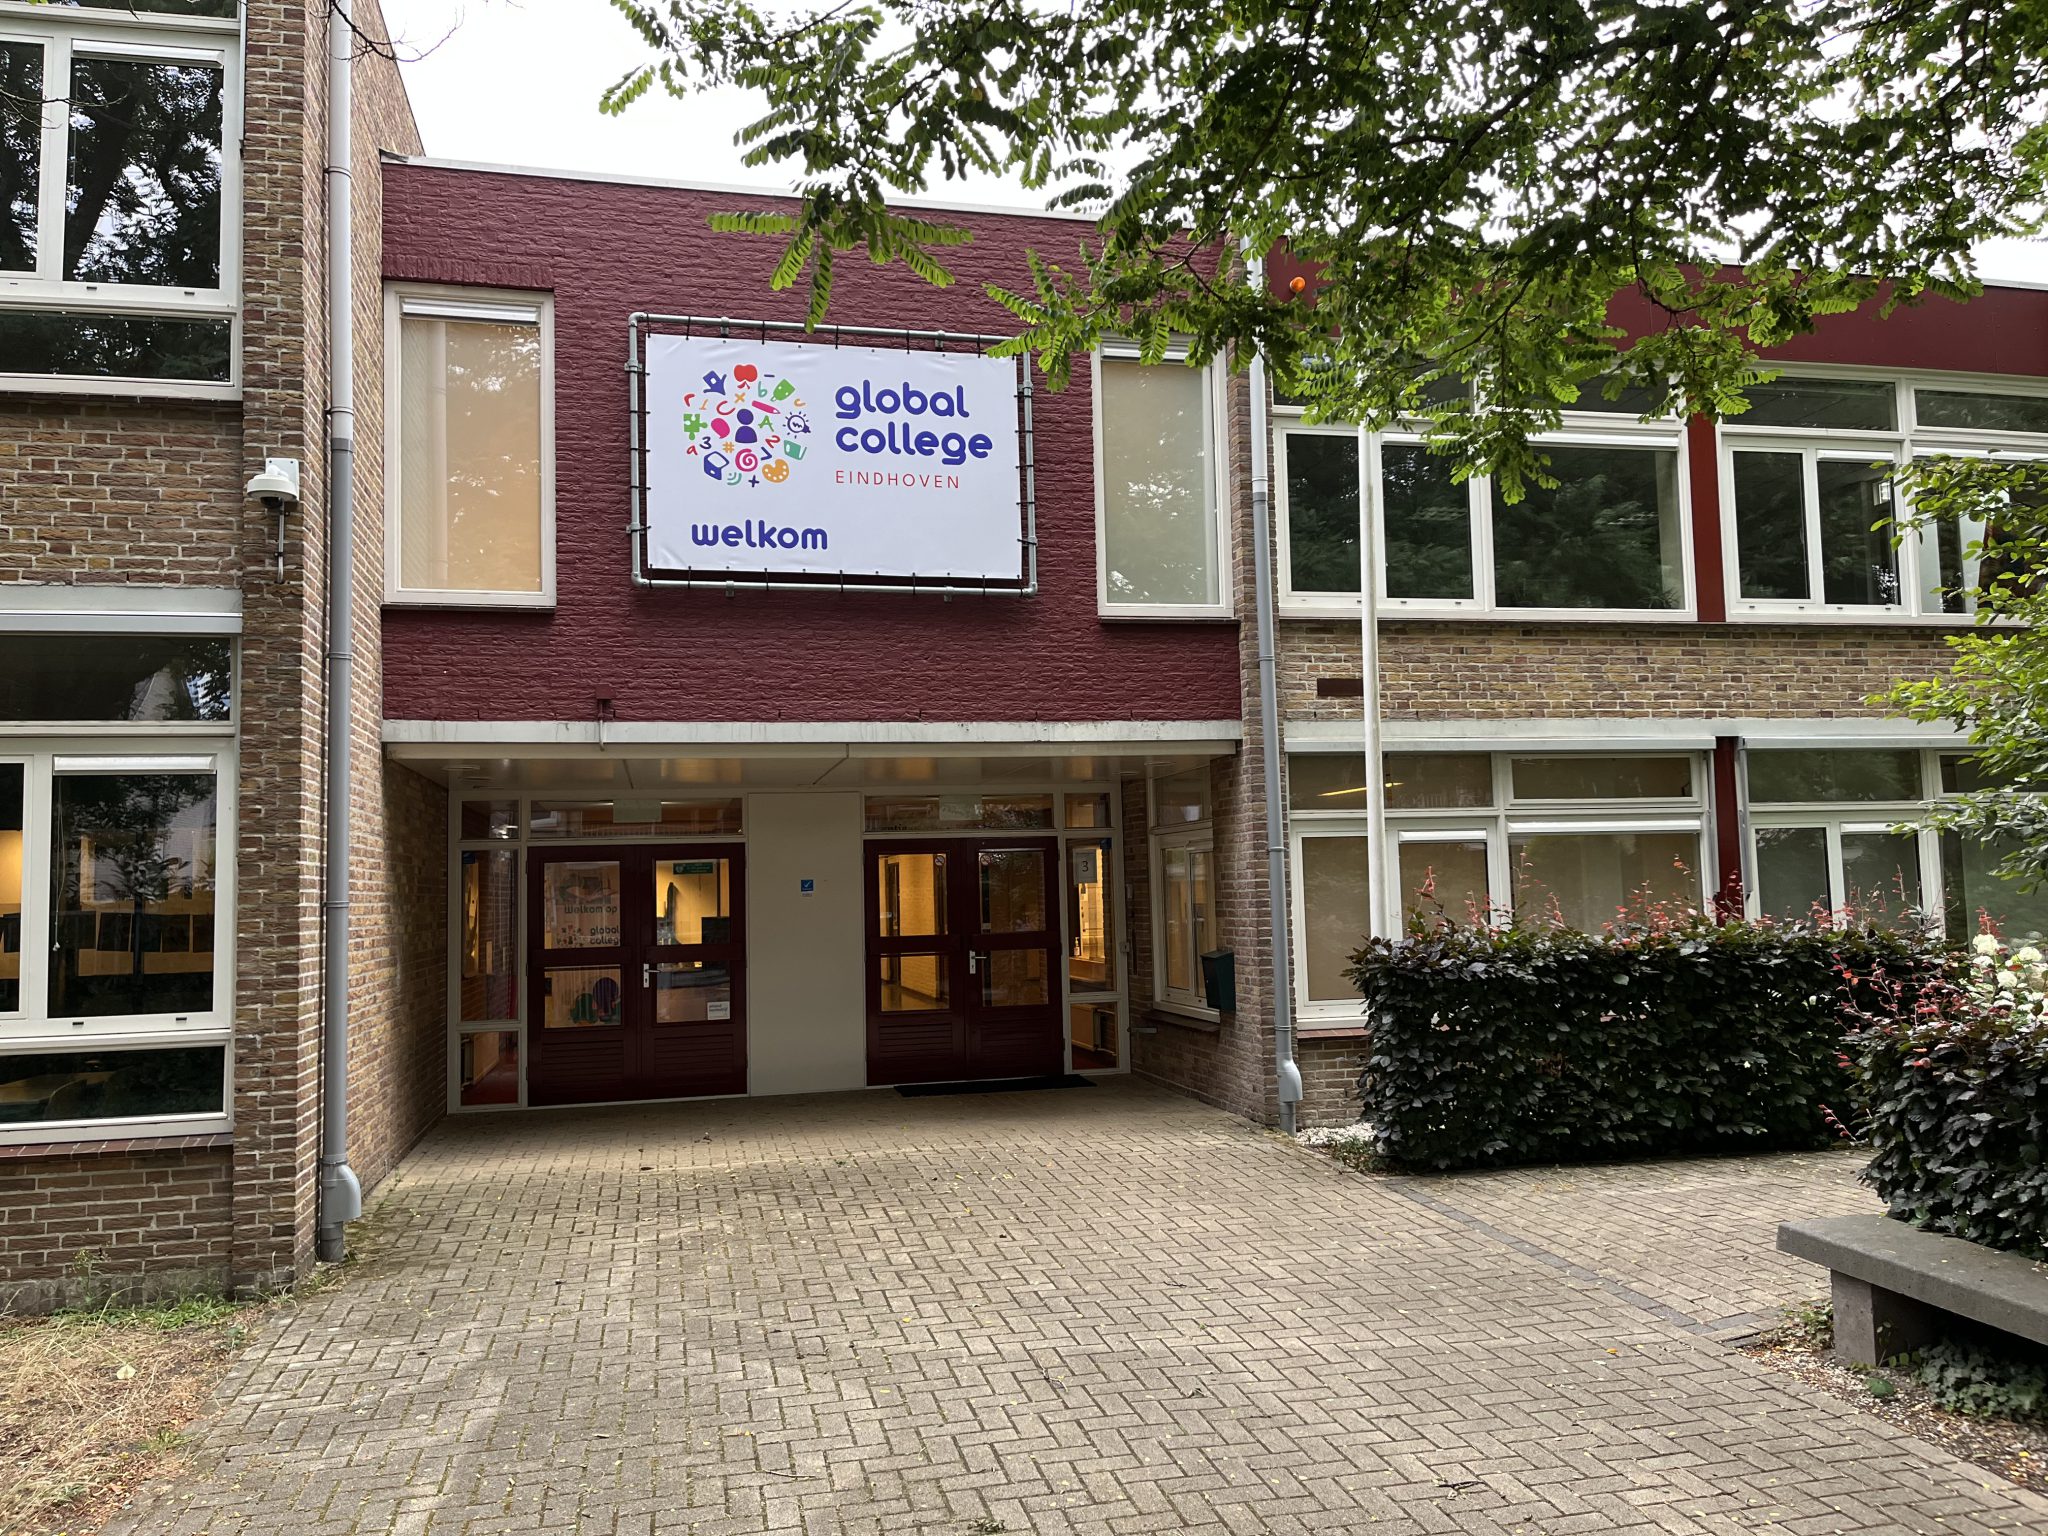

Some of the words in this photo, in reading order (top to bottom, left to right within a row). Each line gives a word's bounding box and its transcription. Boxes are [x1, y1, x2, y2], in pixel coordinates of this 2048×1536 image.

[835, 379, 969, 419] global
[836, 421, 993, 465] college
[835, 470, 960, 488] EINDHOVEN
[692, 520, 828, 550] welkom
[1081, 860, 1089, 872] 3
[605, 905, 618, 915] op
